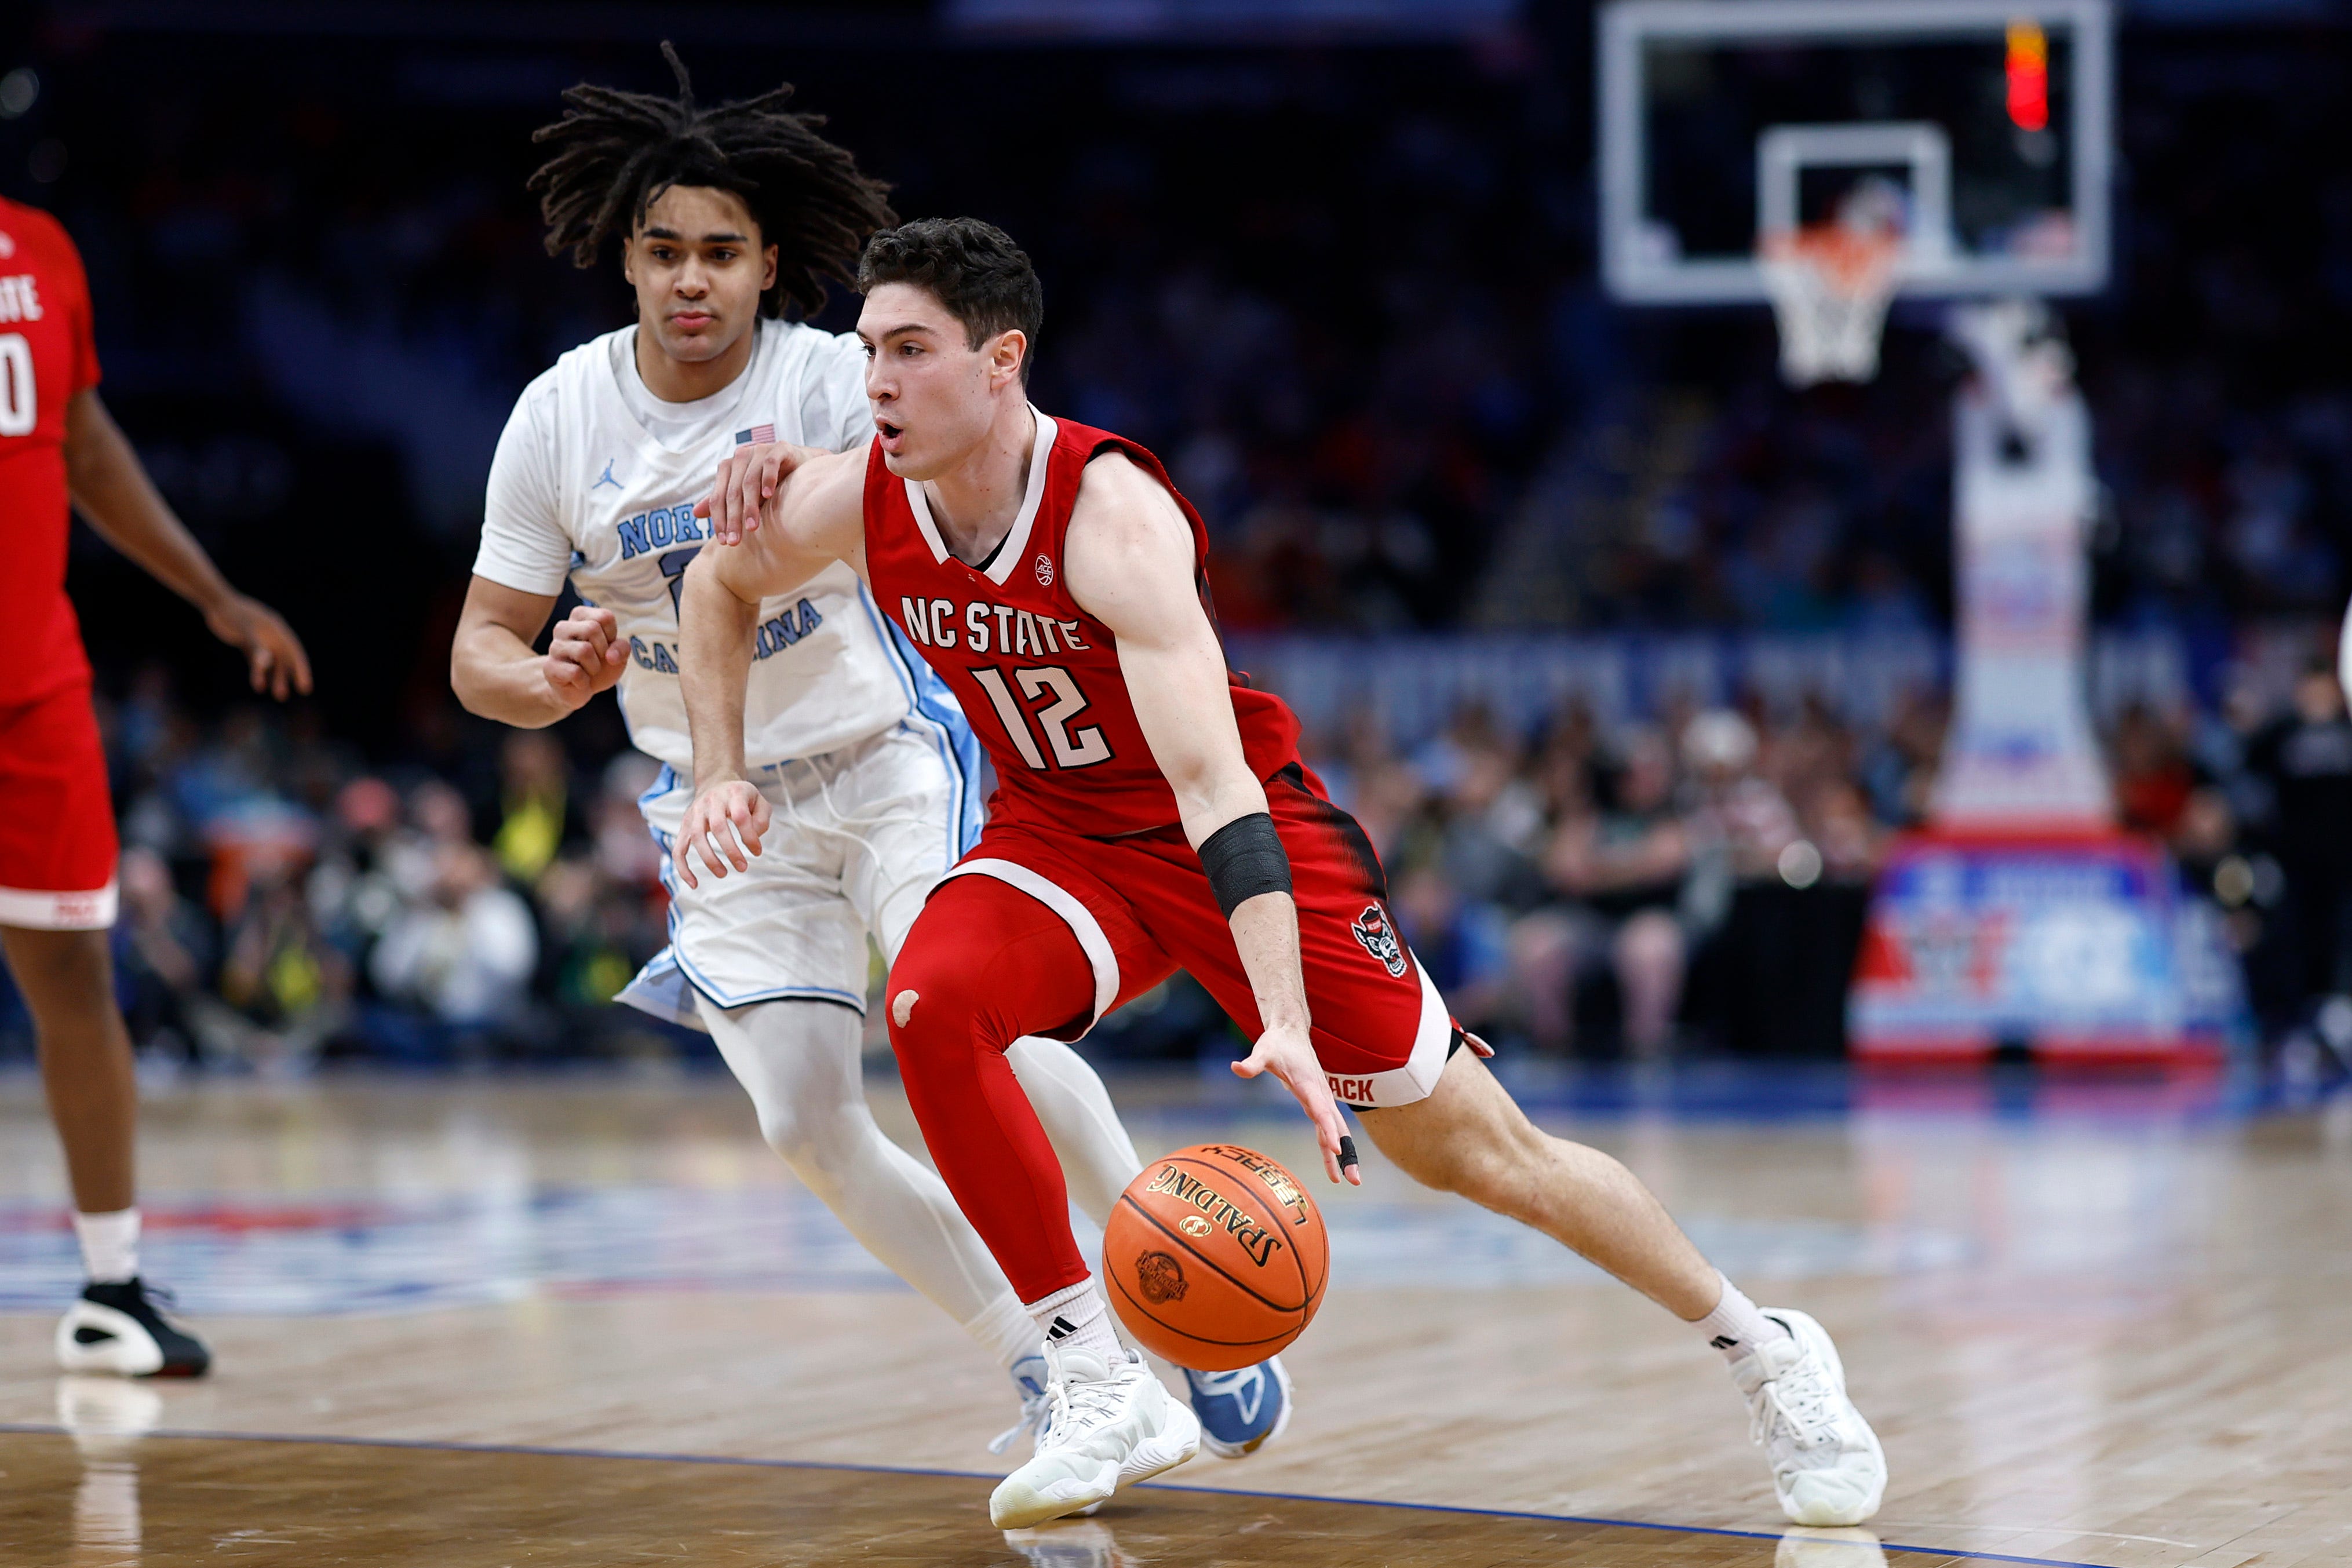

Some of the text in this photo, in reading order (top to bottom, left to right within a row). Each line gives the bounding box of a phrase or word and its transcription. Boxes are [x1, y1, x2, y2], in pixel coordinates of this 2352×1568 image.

[0, 274, 45, 323] TE
[618, 503, 715, 560] NOR
[1037, 564, 1052, 574] ACC
[630, 597, 823, 673] CAINA
[901, 596, 1092, 657] NC STATE
[968, 665, 1115, 771] 12
[1329, 1076, 1374, 1102] ACK
[1146, 1164, 1282, 1268] SPALDING
